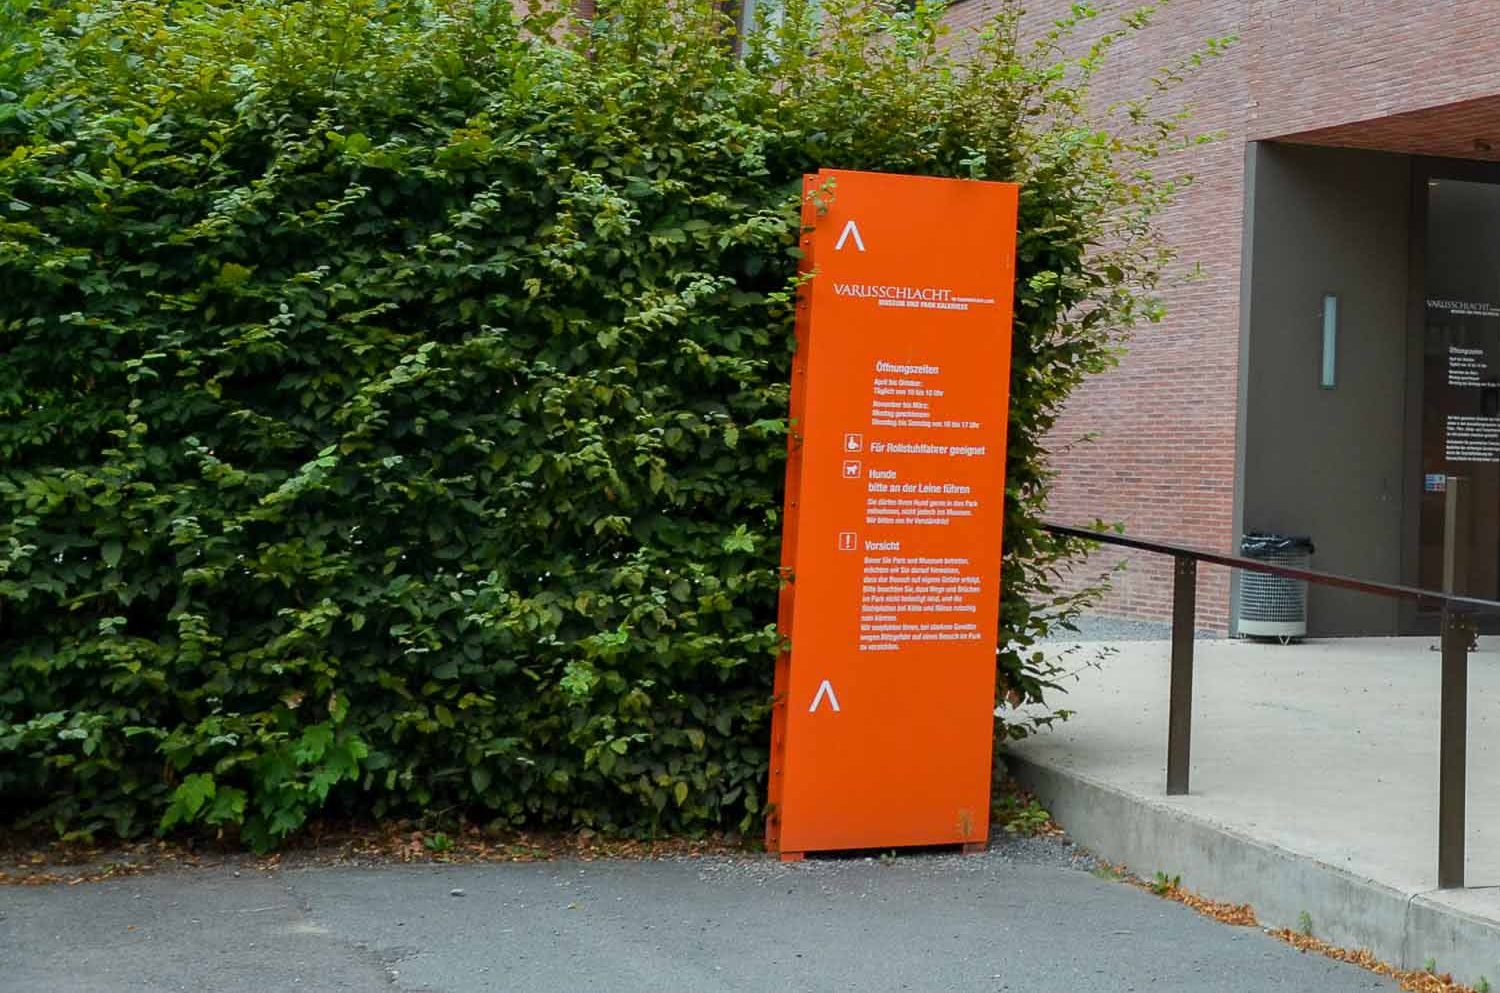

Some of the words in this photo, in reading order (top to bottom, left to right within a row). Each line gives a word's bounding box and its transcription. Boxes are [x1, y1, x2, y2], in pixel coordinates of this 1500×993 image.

[833, 283, 952, 302] VARUSSCHLACHT
[876, 360, 940, 375] Öffnungszeiten
[870, 442, 886, 453] Für
[886, 443, 948, 454] Rollstuhlfahrer
[949, 445, 985, 456] geeignet
[869, 469, 896, 479] Hunde
[868, 482, 888, 492] bitte
[889, 484, 901, 493] an
[902, 483, 917, 493] der
[918, 483, 942, 494] Leine
[943, 483, 970, 494] führen
[864, 541, 900, 551] Vorsicht
